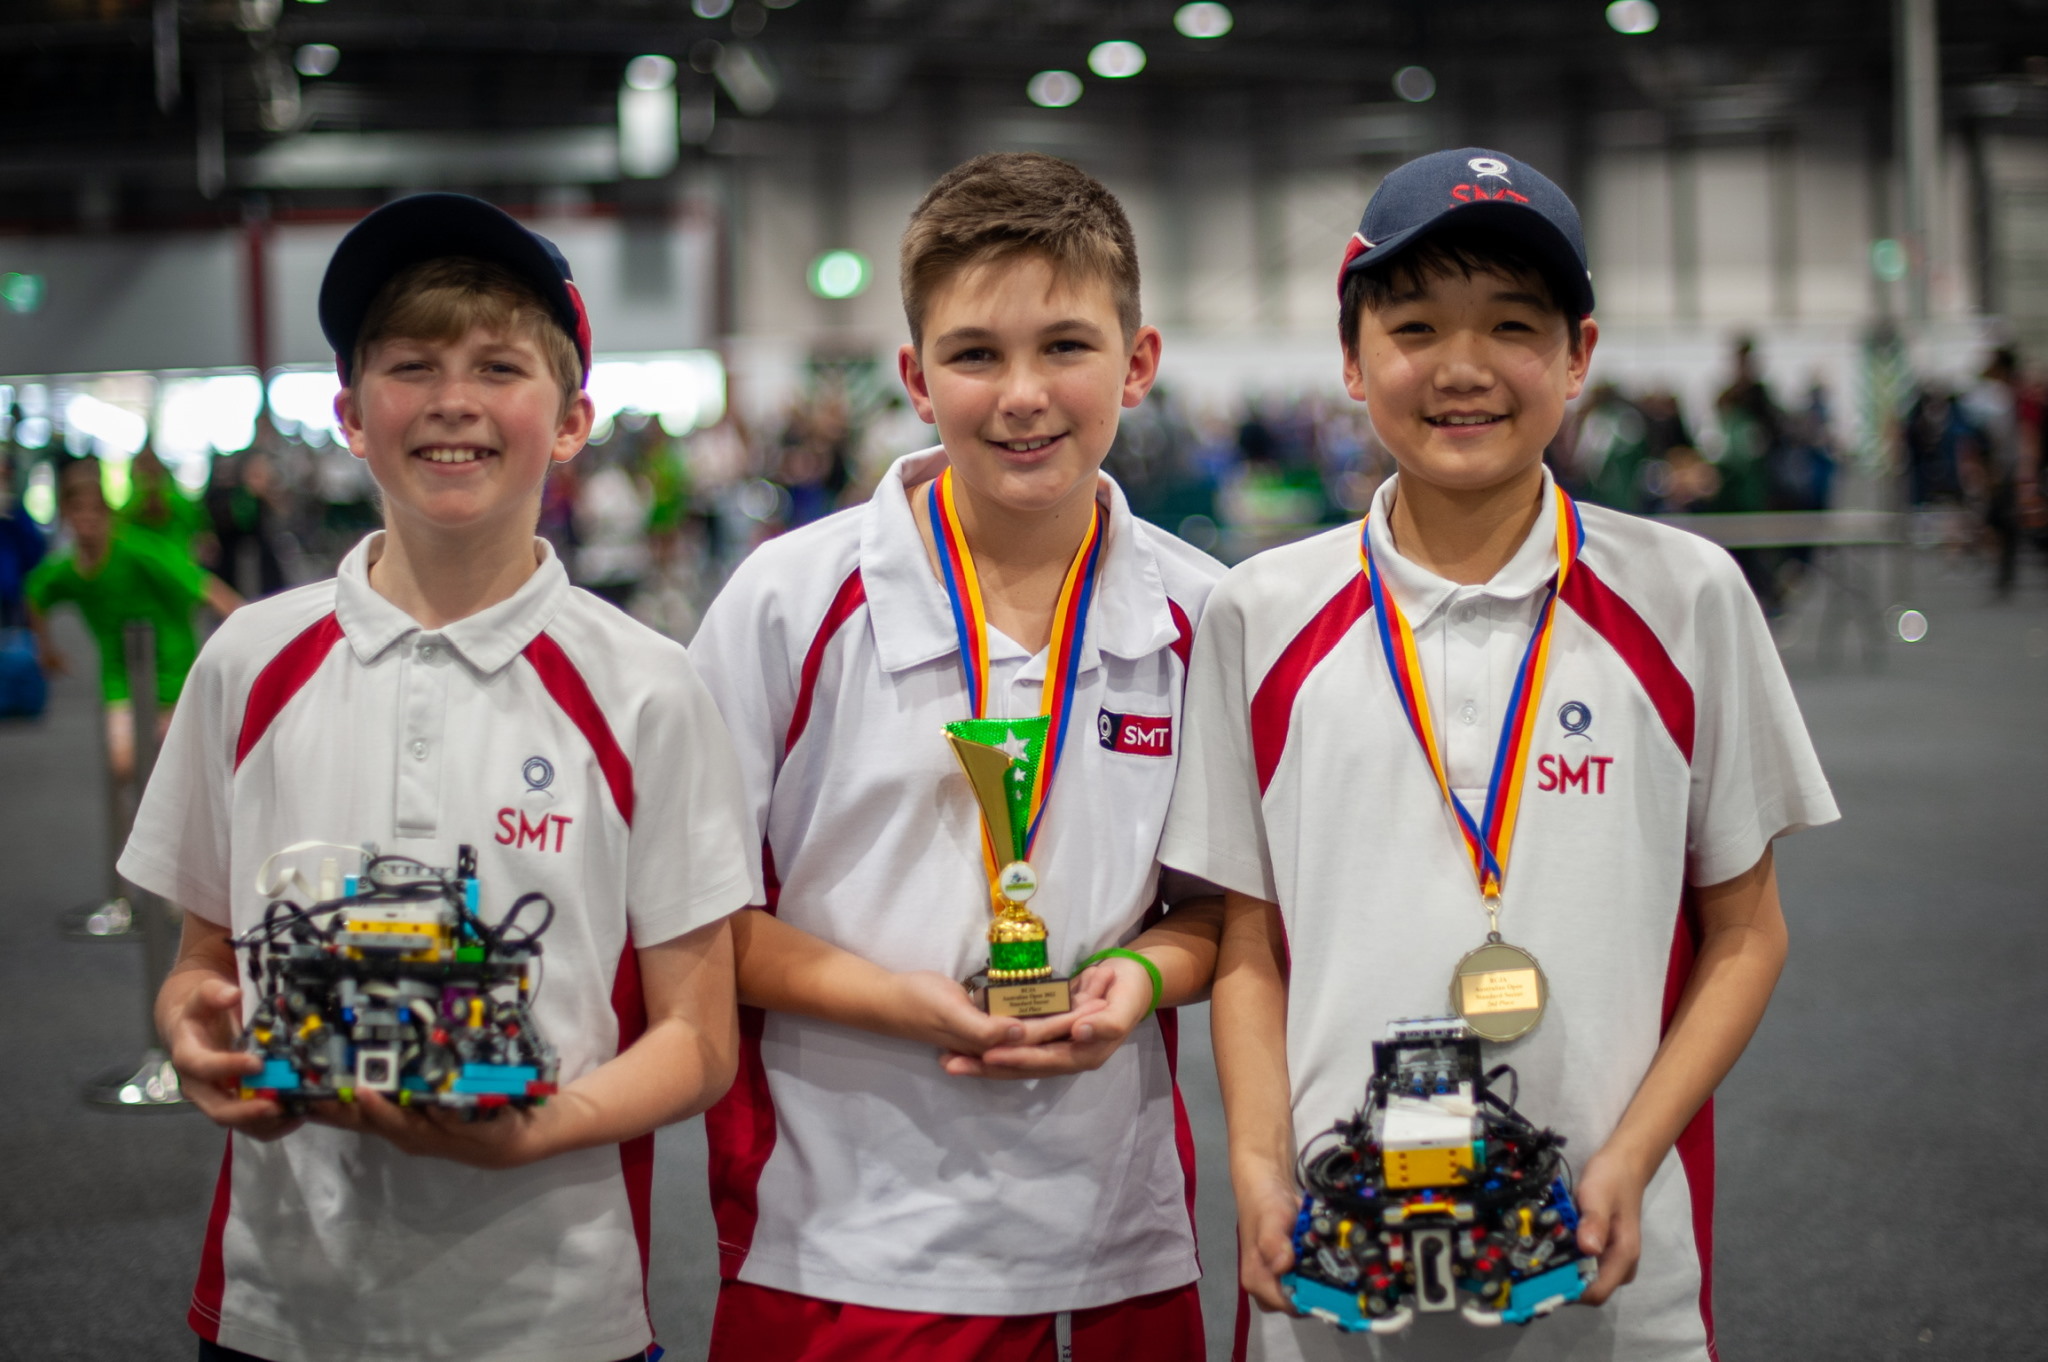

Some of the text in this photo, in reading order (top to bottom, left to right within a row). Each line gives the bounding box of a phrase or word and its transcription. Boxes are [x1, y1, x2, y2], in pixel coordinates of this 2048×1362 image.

[1123, 725, 1169, 748] SMT
[1537, 753, 1614, 795] SMT
[494, 806, 574, 853] SMT
